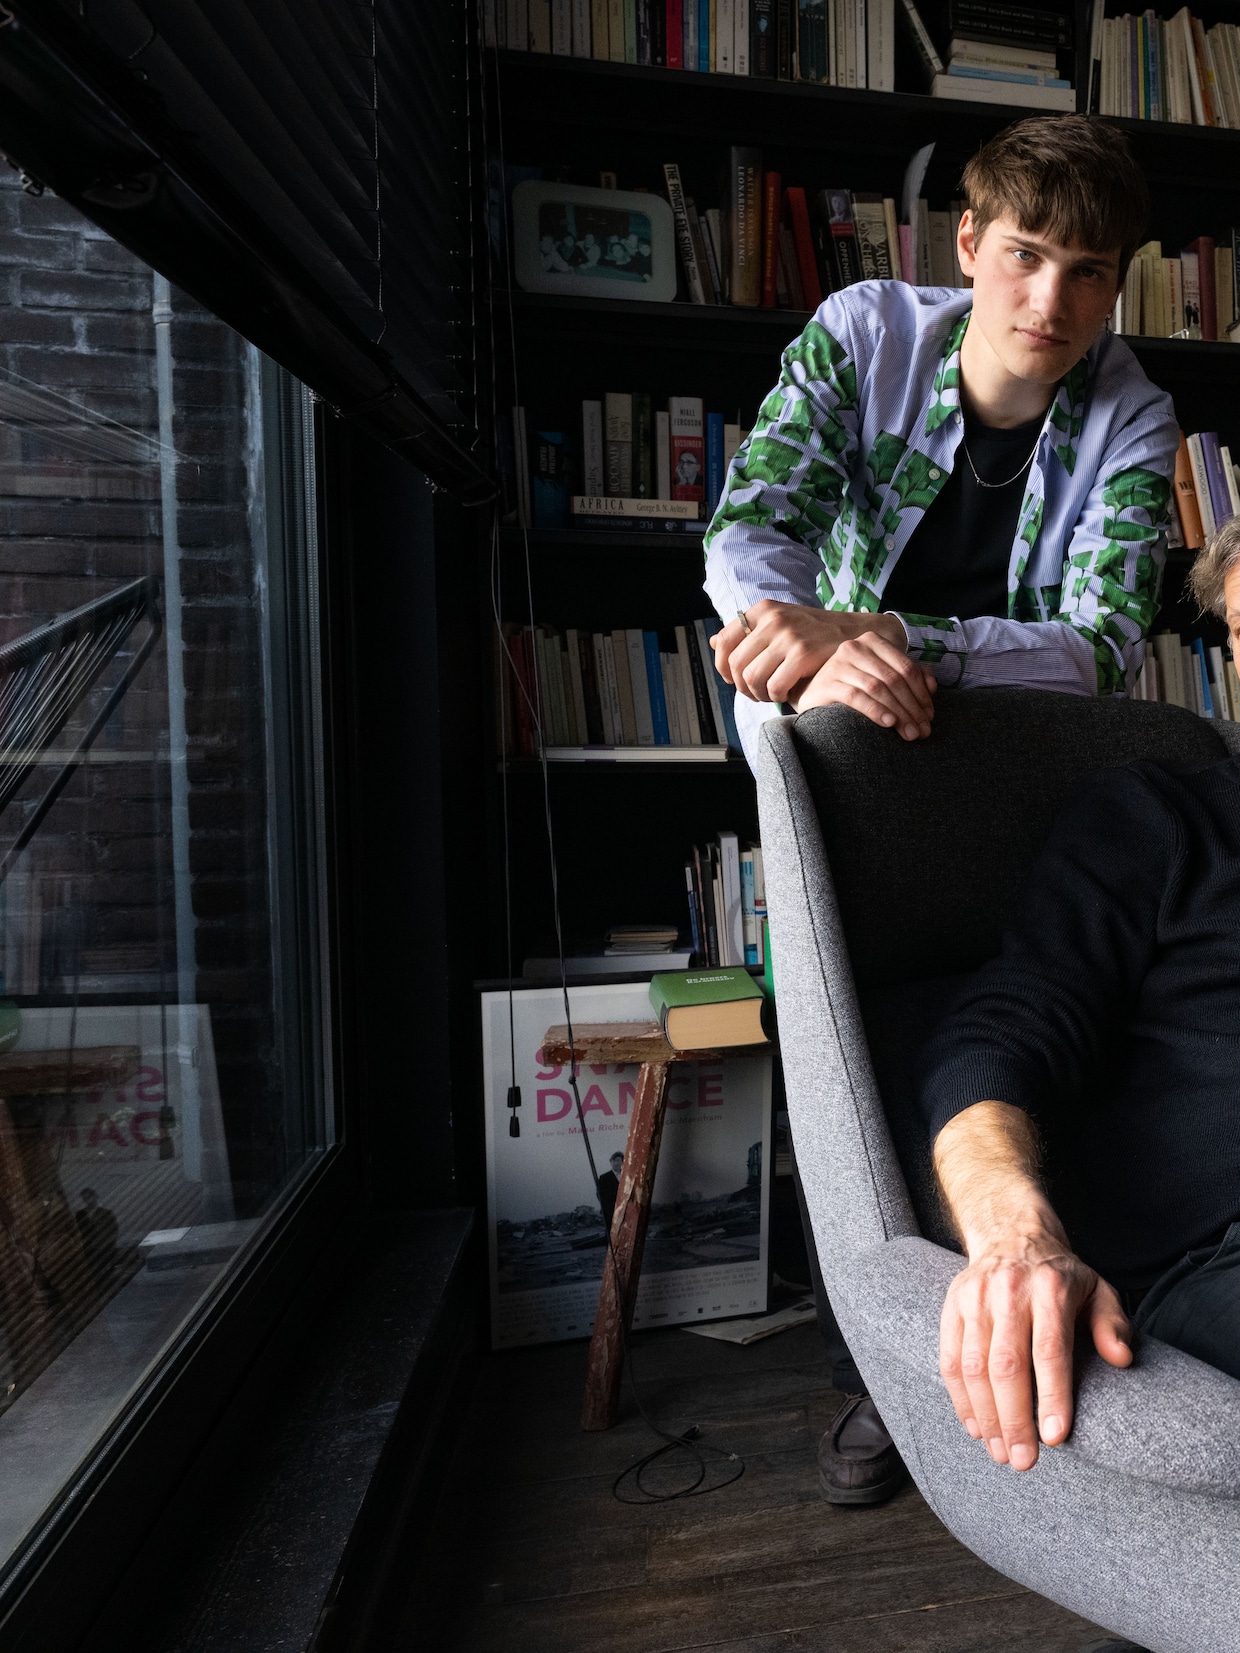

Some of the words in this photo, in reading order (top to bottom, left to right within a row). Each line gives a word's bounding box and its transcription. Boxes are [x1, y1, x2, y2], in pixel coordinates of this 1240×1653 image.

[666, 166, 680, 180] THE
[670, 184, 685, 215] PRIVATE
[675, 218, 689, 233] EYE
[738, 222, 745, 236] DA
[679, 236, 694, 263] STORY
[674, 418, 701, 426] FERGUSON
[674, 440, 702, 448] KISSINGER
[609, 445, 619, 492] ATWOOD
[1197, 464, 1208, 495] ATWOOD
[579, 498, 624, 510] AFRICA
[637, 504, 654, 512] George
[663, 504, 669, 512] N.
[598, 1123, 624, 1131] Riche
[679, 1114, 722, 1124] Marnham
